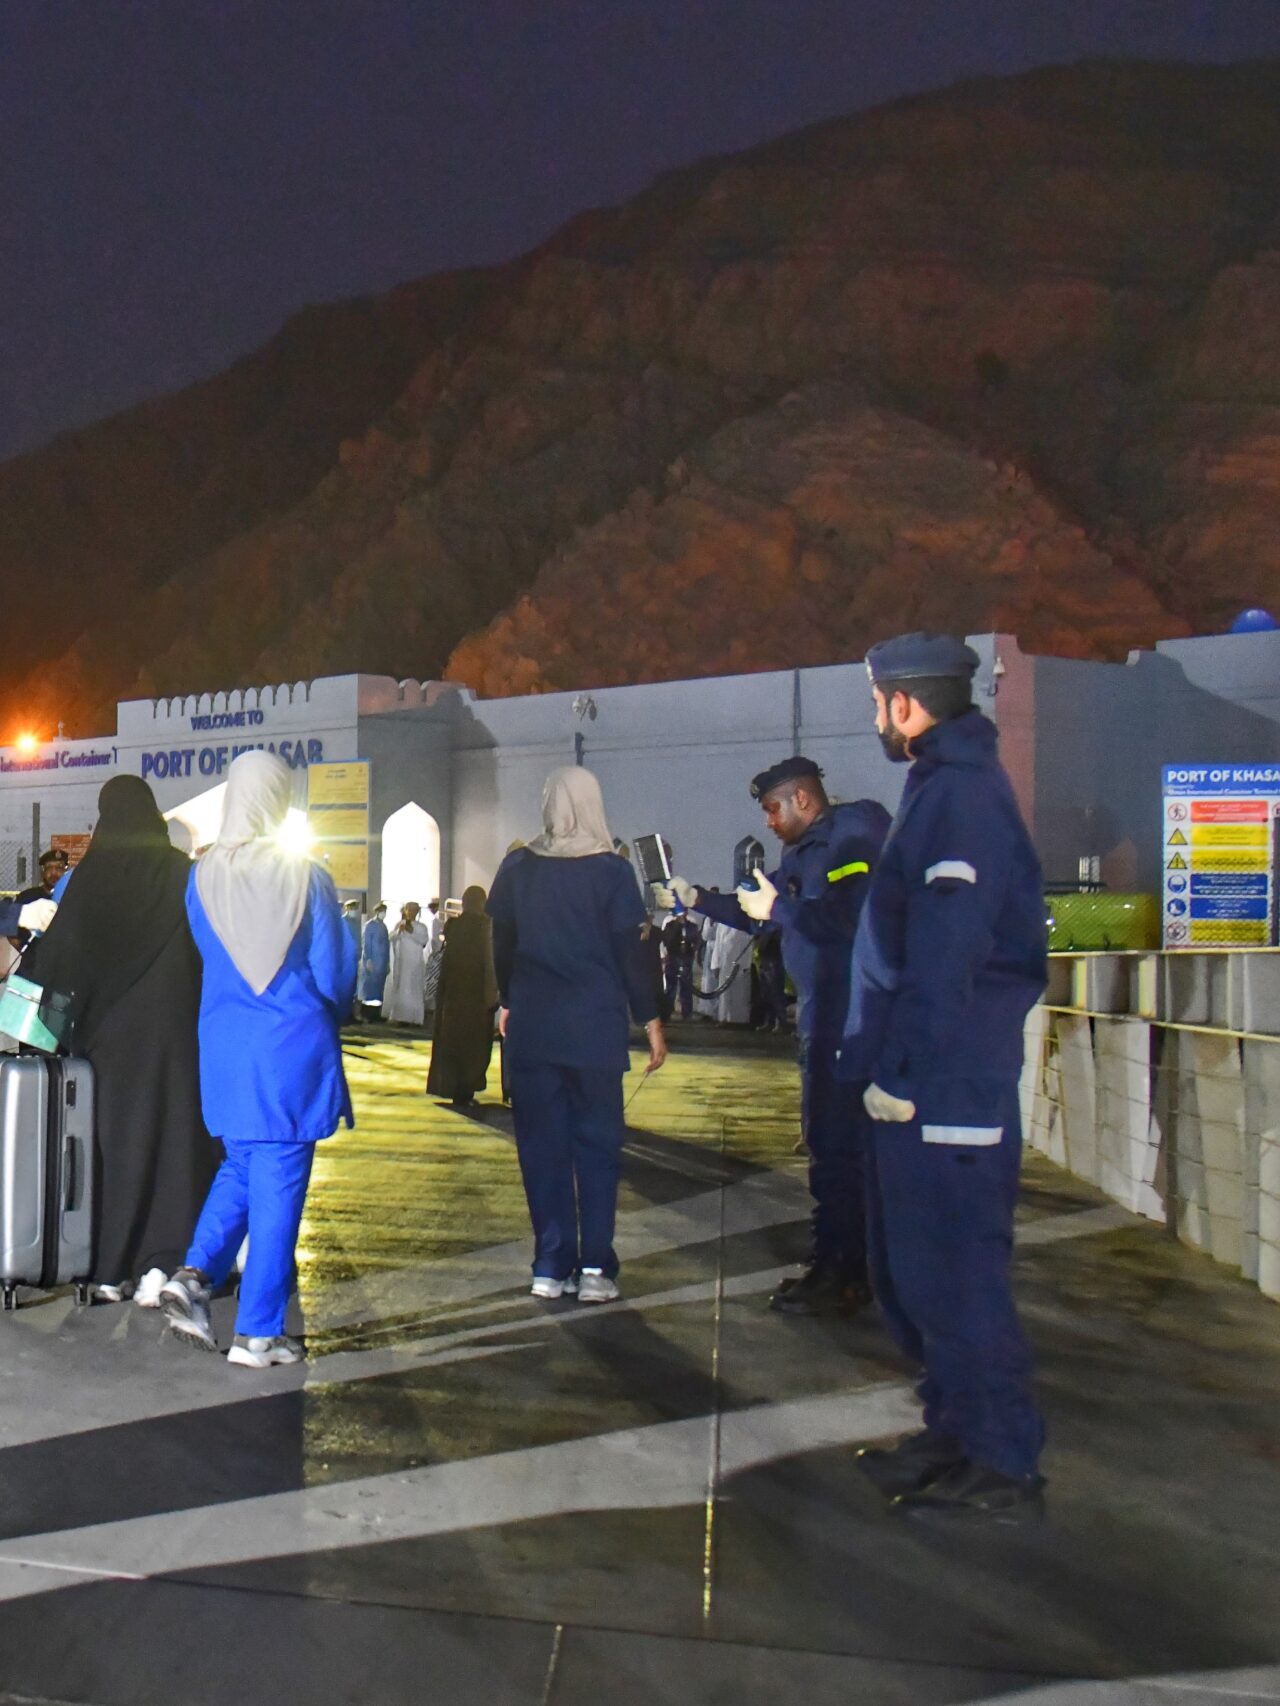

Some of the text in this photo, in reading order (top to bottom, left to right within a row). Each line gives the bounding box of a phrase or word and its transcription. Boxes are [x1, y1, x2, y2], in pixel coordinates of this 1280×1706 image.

[190, 710, 264, 731] WELCOME TO
[61, 750, 111, 768] Container
[141, 749, 195, 779] PORT
[198, 746, 229, 776] OF
[1167, 770, 1208, 782] PORT
[1209, 769, 1231, 782] OF
